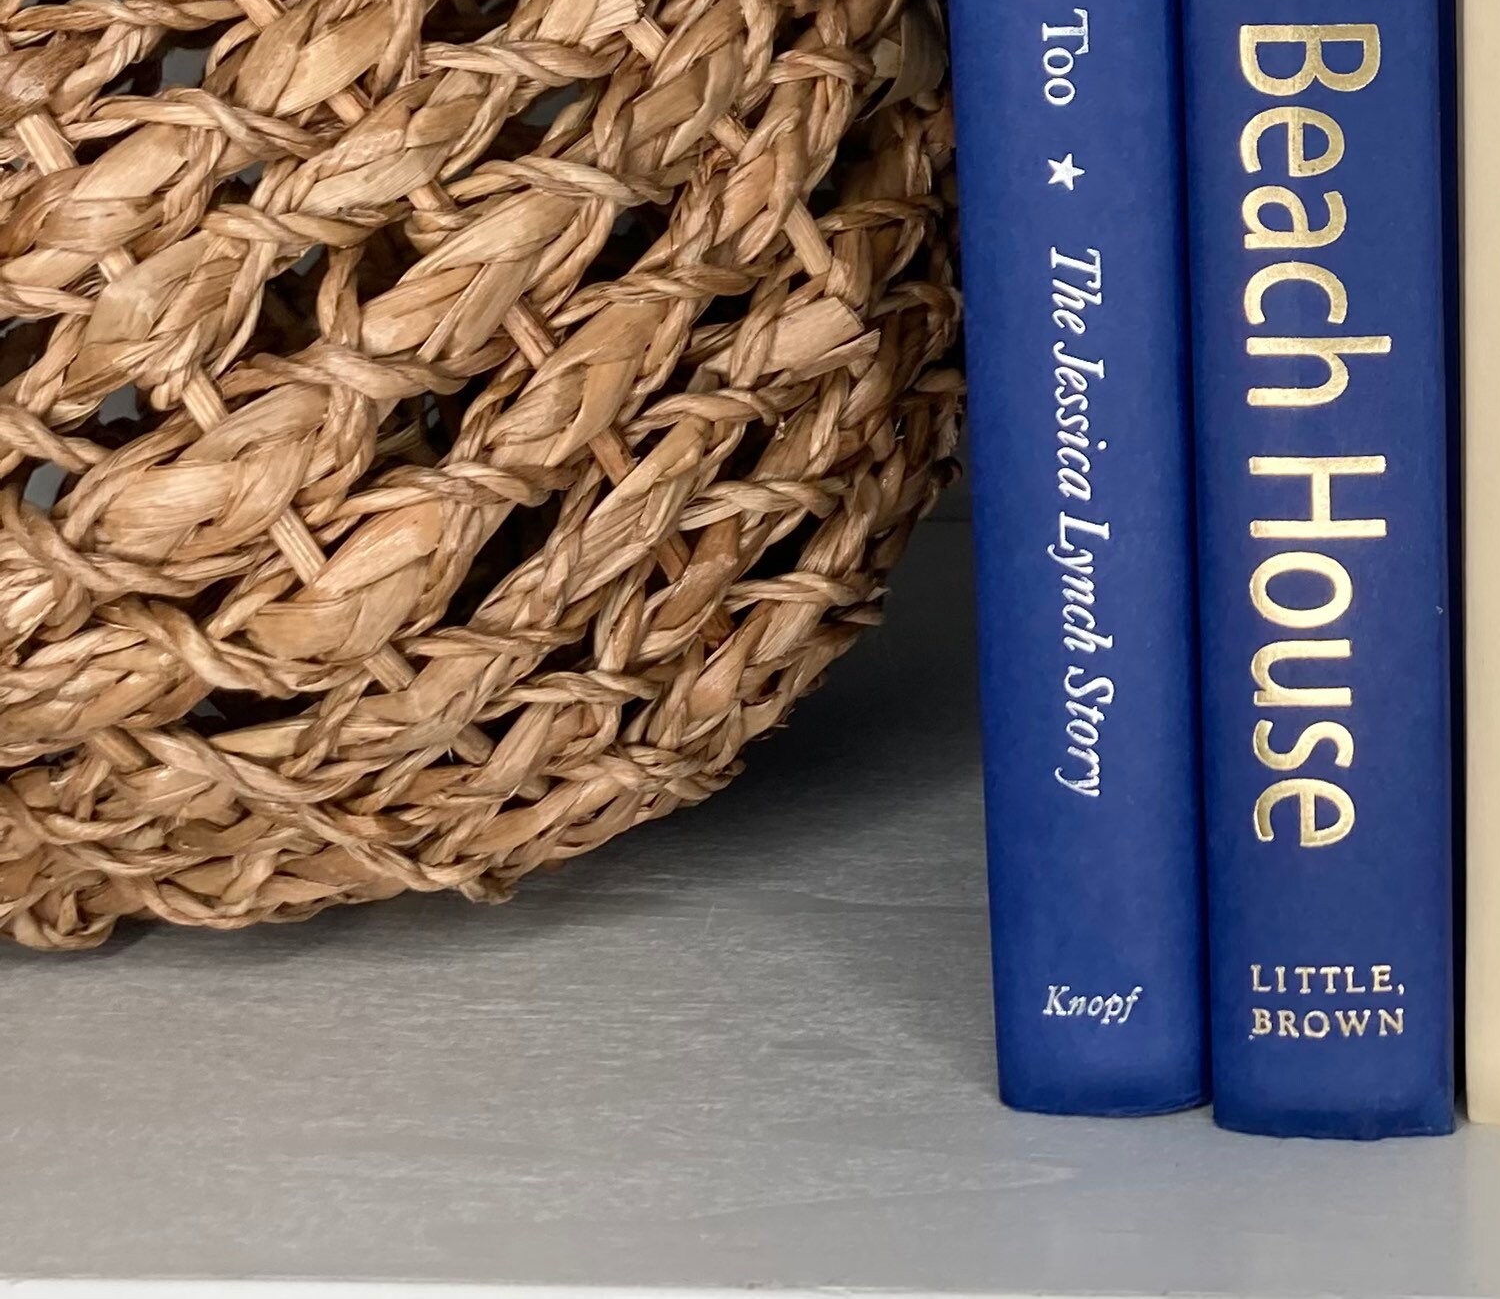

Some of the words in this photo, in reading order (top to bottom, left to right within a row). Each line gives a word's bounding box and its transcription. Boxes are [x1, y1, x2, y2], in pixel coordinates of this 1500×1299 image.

[1041, 7, 1091, 107] Too
[1239, 23, 1392, 407] Beach
[1050, 246, 1103, 335] The
[1052, 339, 1108, 502] Jessica
[1046, 510, 1114, 656] Lynch
[1248, 454, 1388, 849] House
[1054, 666, 1116, 798] Story
[1042, 984, 1143, 1025] Knopf
[1249, 963, 1406, 997] LITTLE,
[1250, 1007, 1405, 1039] BROWN
